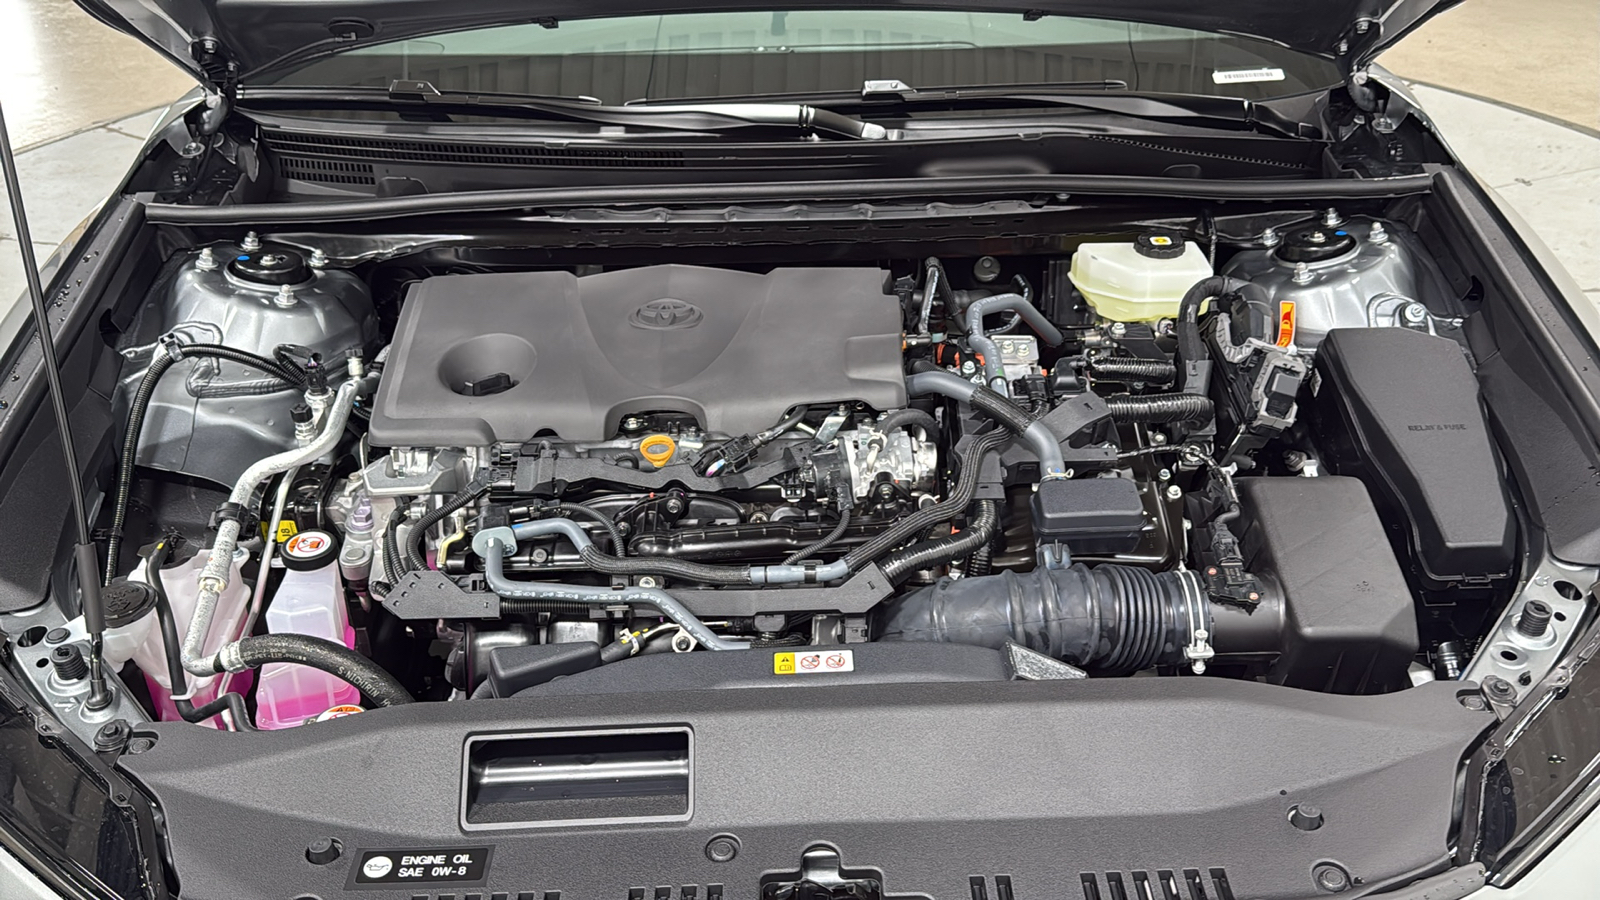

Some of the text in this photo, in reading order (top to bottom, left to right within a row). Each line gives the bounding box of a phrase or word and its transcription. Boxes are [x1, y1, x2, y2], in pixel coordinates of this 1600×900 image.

[401, 854, 473, 866] ENGINE OIL
[398, 866, 466, 878] SAE 0W-8
